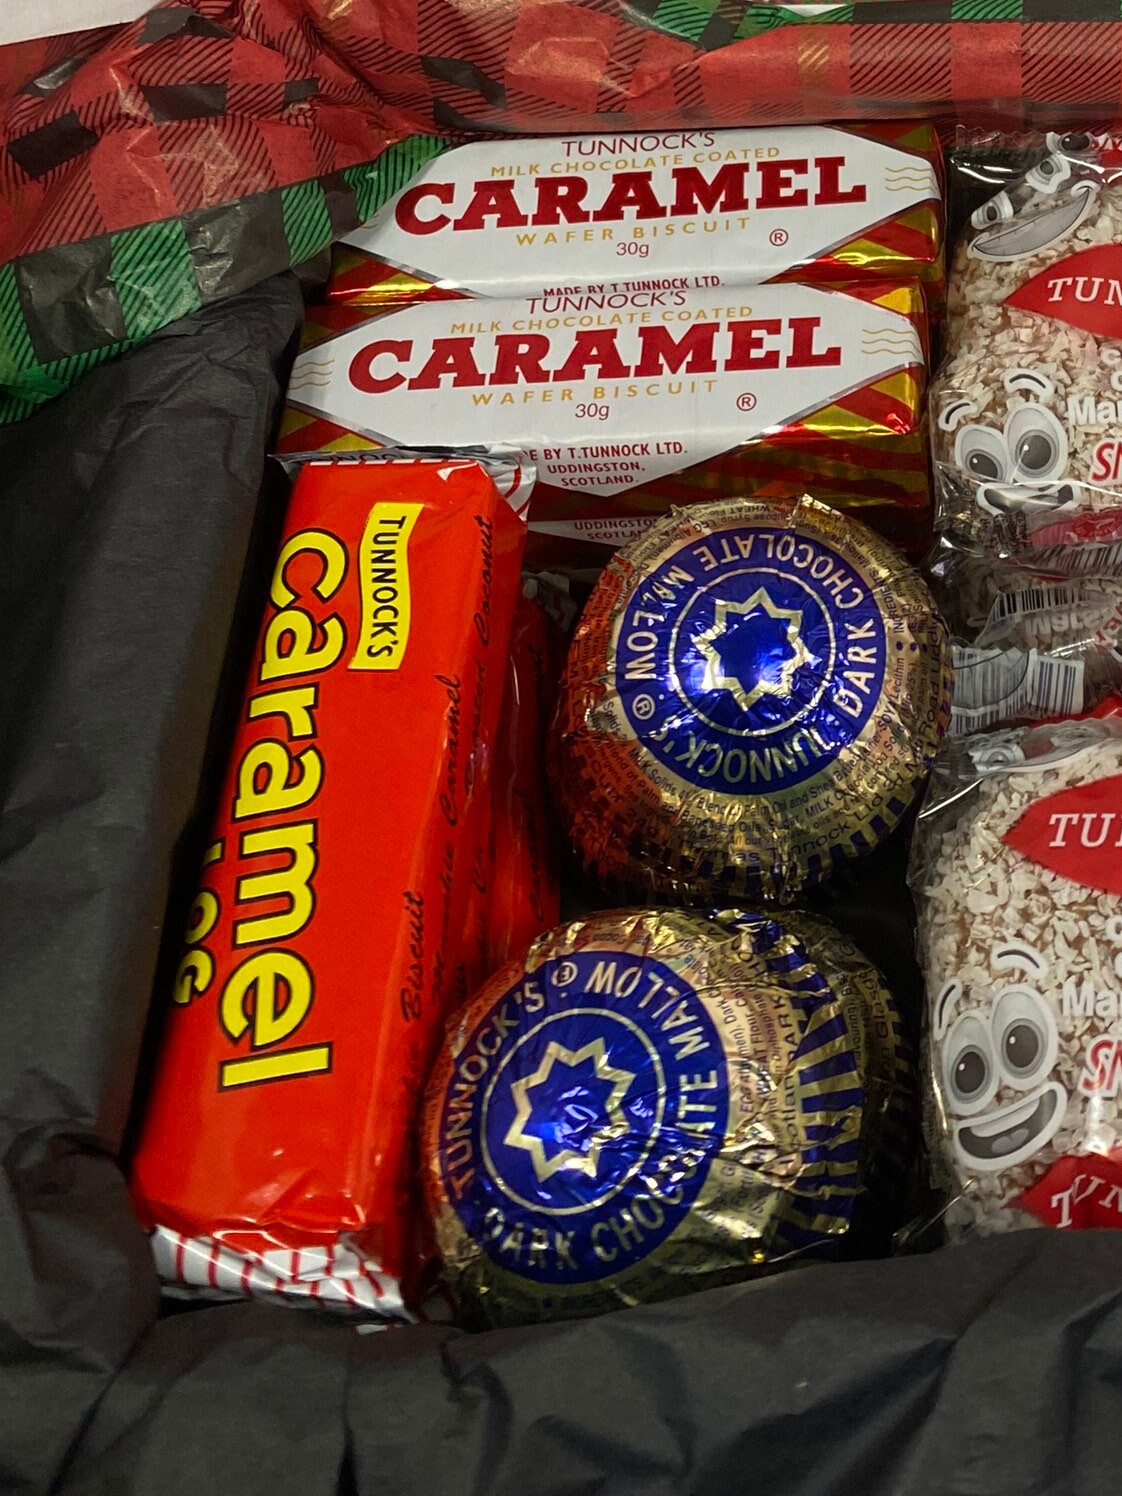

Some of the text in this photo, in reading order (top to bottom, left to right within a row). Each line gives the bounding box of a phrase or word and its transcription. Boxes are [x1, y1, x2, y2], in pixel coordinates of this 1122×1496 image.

[490, 146, 780, 177] MILK CHOCOLATE COATED
[561, 131, 716, 158] TUNNOCK'S
[394, 155, 867, 236] CARAMEL
[516, 216, 750, 246] WAFER BISCUIT
[616, 242, 650, 258] 30g
[450, 306, 753, 335] MILK CHOCOLATE COATED
[526, 290, 686, 315] TUNNOCK'S
[348, 316, 842, 395] CARAMEL
[472, 379, 718, 406] WAFER BISCUIT
[574, 403, 610, 421] 30g
[543, 447, 562, 461] BY
[655, 441, 688, 455] LTD.
[546, 461, 646, 474] UDDINGSTON,
[560, 474, 639, 487] SCOTLAND.
[366, 514, 407, 659] TUNNOCK'S
[473, 516, 493, 647] Coconut
[692, 533, 866, 610] CHOCOLATE
[623, 564, 695, 681] MALLOW
[836, 617, 878, 718] DARK
[433, 674, 458, 825] Caramel
[218, 527, 349, 1093] Caramel
[803, 795, 835, 818] MILK
[762, 817, 854, 858] Tnnock
[400, 891, 425, 1022] Biscuit
[441, 980, 546, 1201] TUNNOCK'S
[482, 1206, 580, 1271] DARK
[584, 960, 710, 1060] MALLOW
